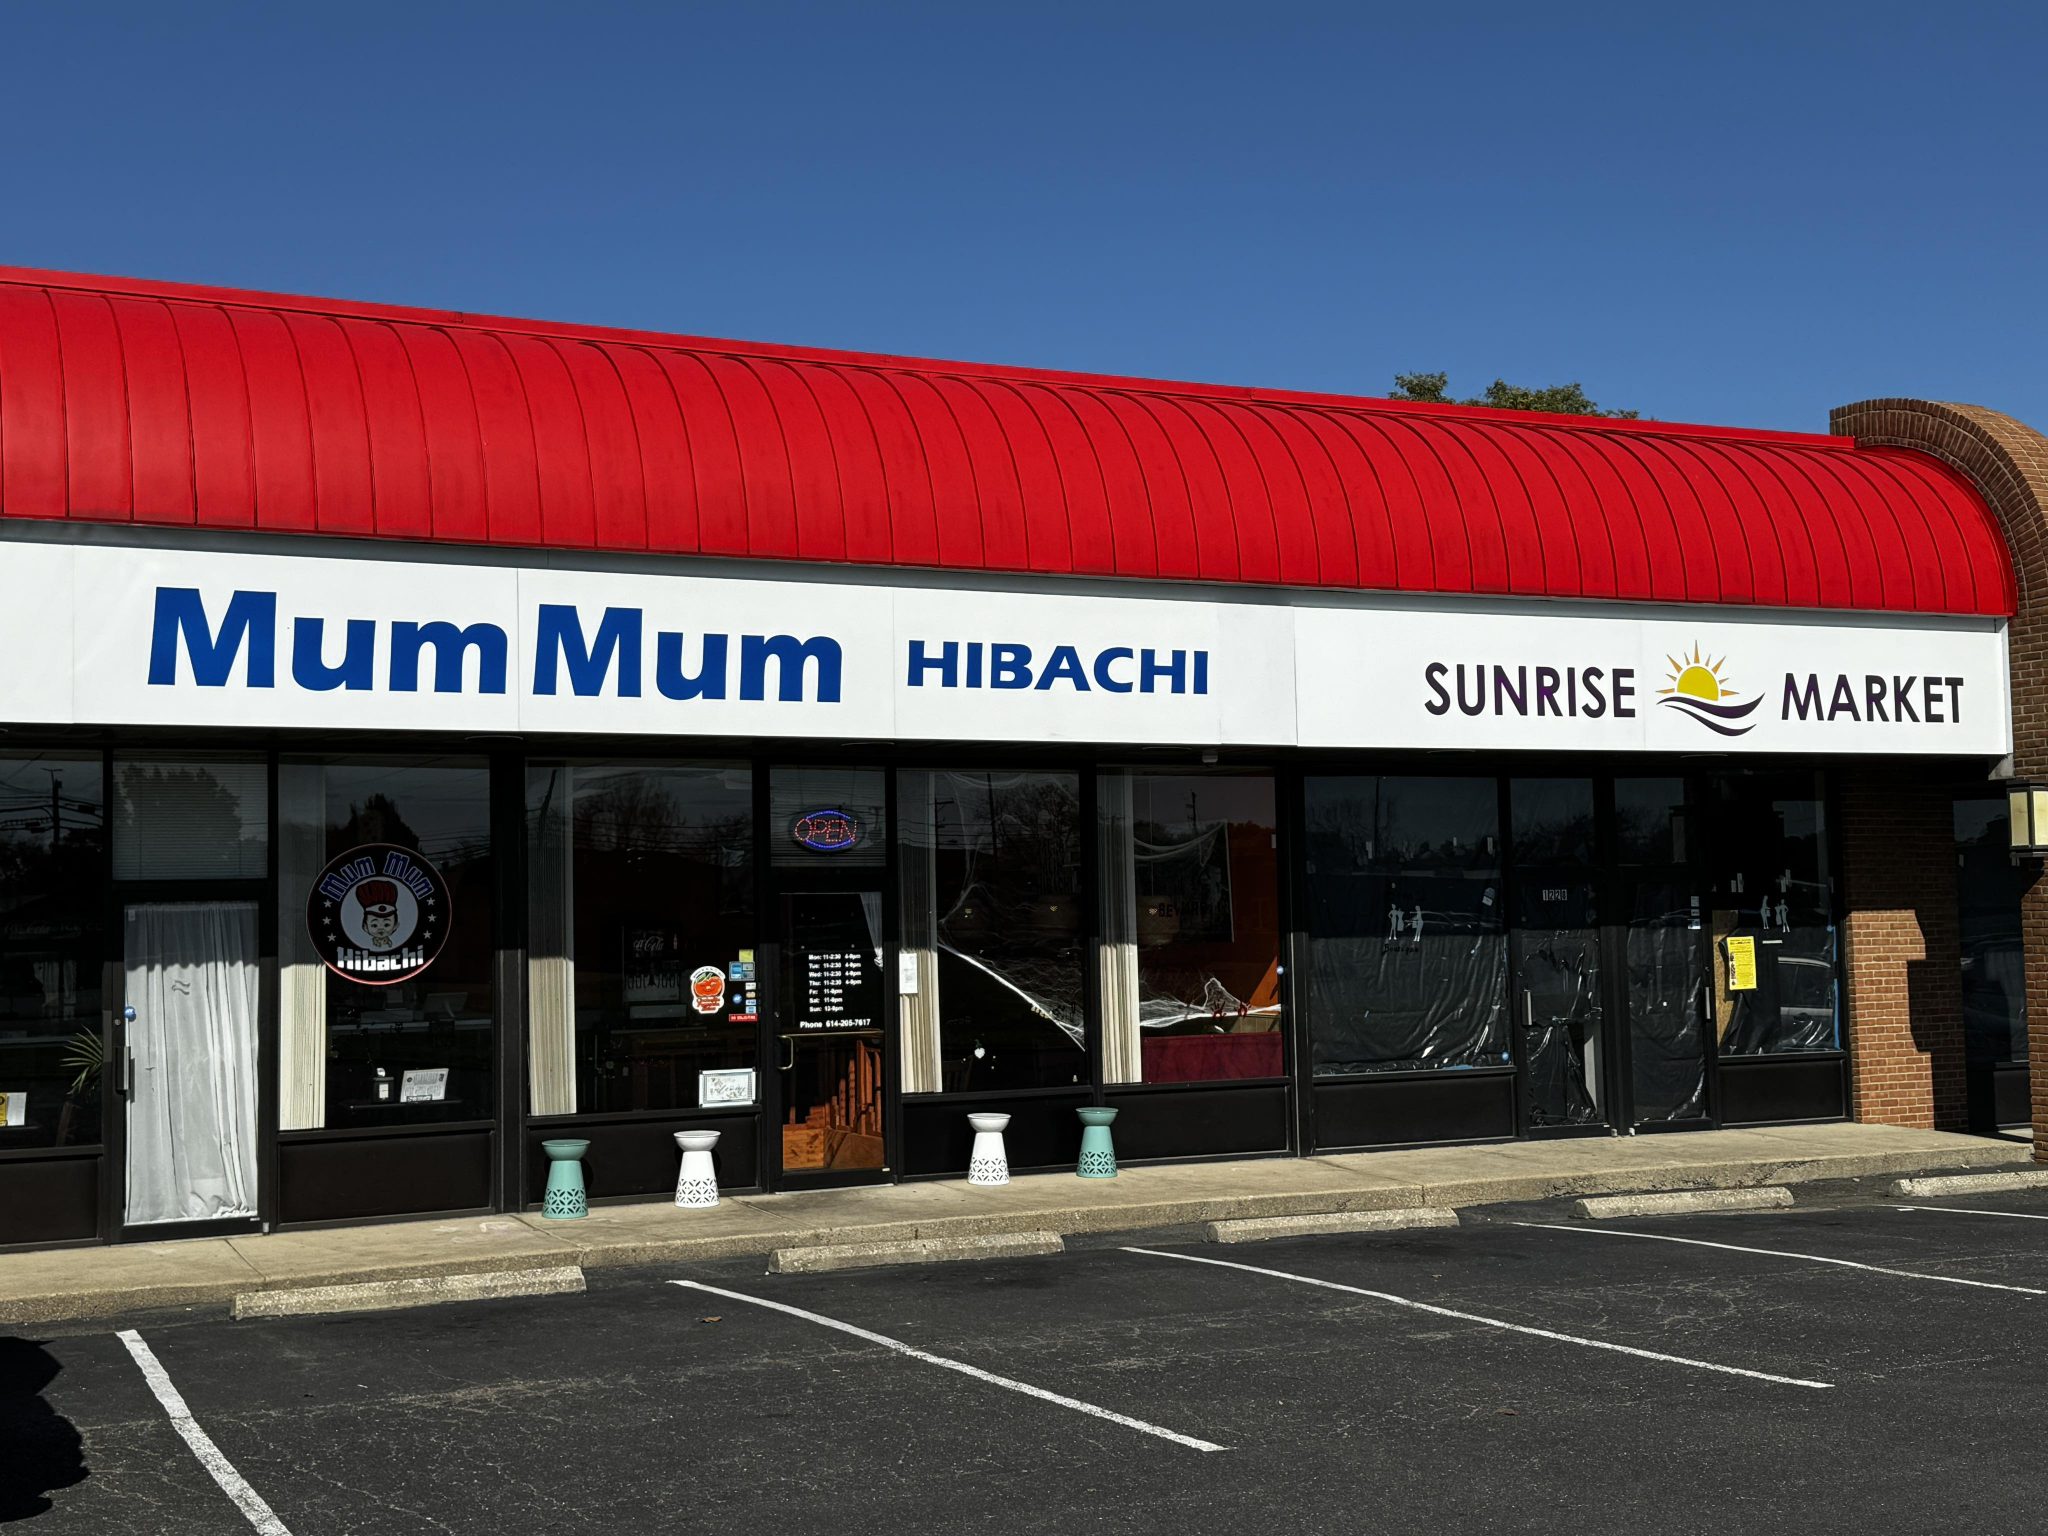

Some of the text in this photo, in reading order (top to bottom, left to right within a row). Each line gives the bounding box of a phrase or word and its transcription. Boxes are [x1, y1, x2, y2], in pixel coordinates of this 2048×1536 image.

[148, 587, 1209, 703] Mum Mum HIBACHI
[1424, 662, 1637, 719] SUNRISE
[1781, 672, 1965, 724] MARKET
[795, 818, 857, 842] OPEN
[337, 945, 424, 971] Hibachi
[800, 1020, 823, 1028] Phone
